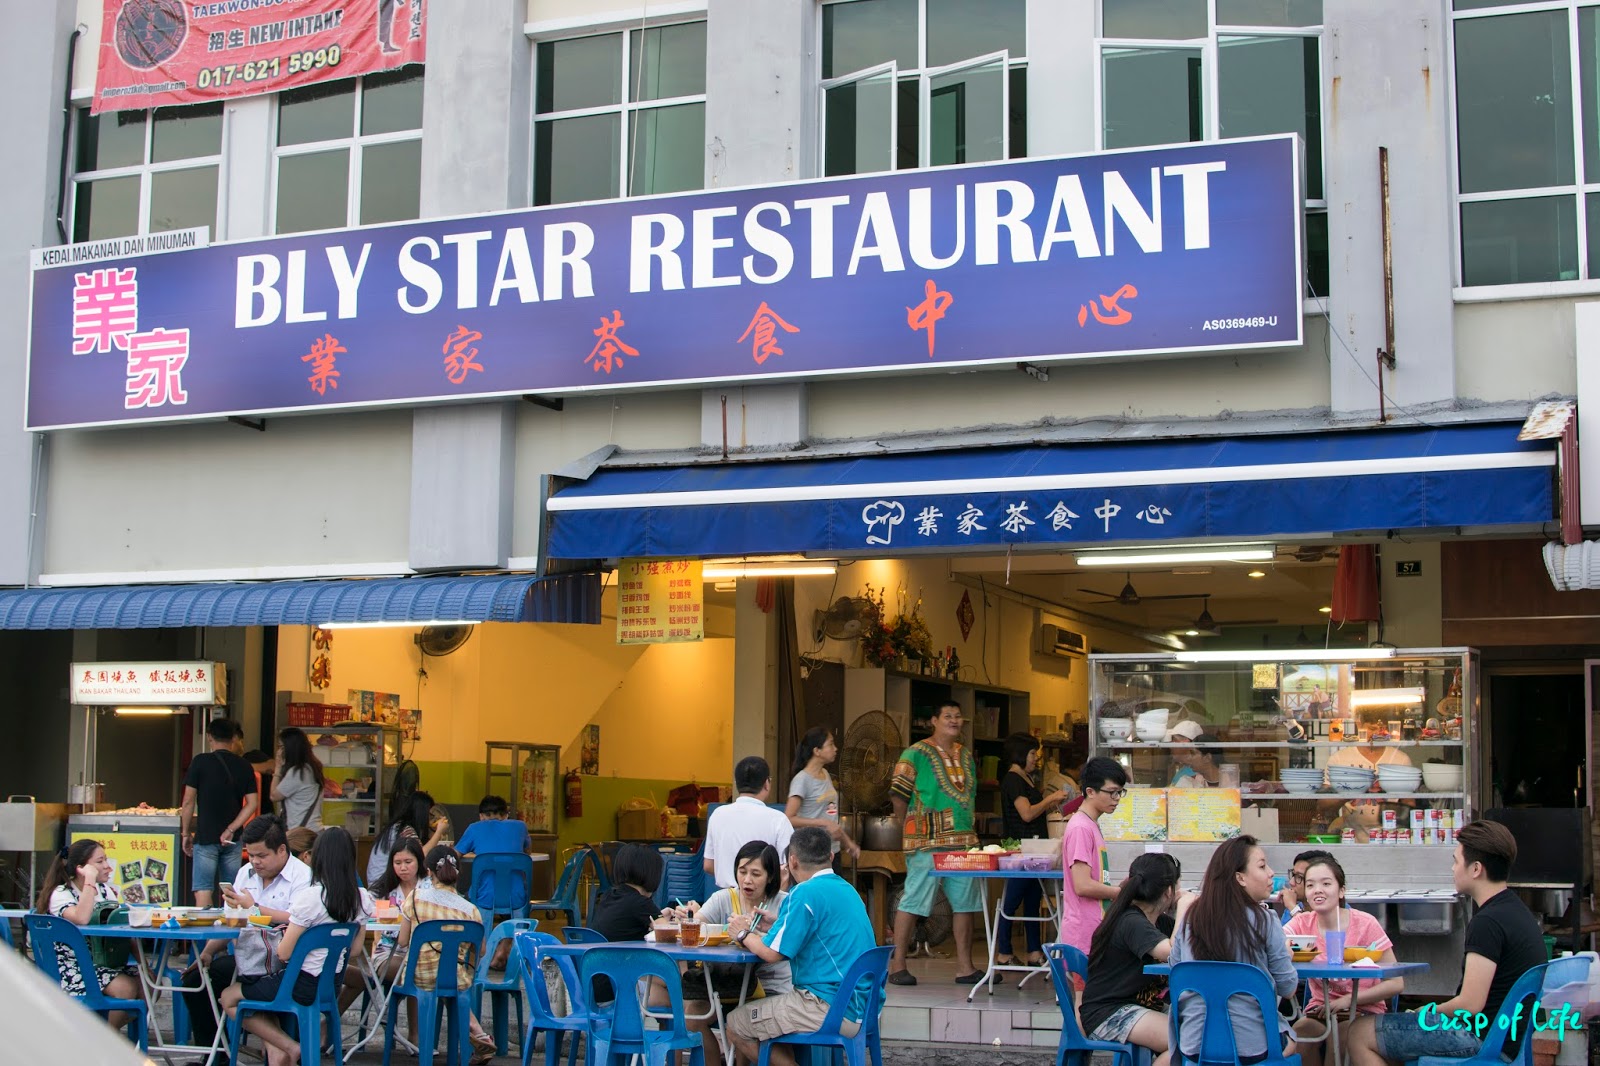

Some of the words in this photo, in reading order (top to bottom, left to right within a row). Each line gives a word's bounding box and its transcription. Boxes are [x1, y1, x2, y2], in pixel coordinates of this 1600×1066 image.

[208, 30, 244, 51] 招生
[249, 22, 284, 45] NEW
[288, 10, 343, 38] INTAKE
[197, 57, 280, 89] 017-621
[288, 43, 341, 74] 5990
[43, 248, 70, 265] KEDAI
[73, 242, 121, 261] MAKANAN
[125, 238, 144, 254] DAN
[147, 232, 196, 251] MINUMAN
[235, 242, 372, 329] BLY
[397, 222, 595, 315] STAR
[630, 161, 1226, 294] RESTAURANT
[1202, 316, 1278, 331] AS0369469-U
[1403, 563, 1415, 573] 57
